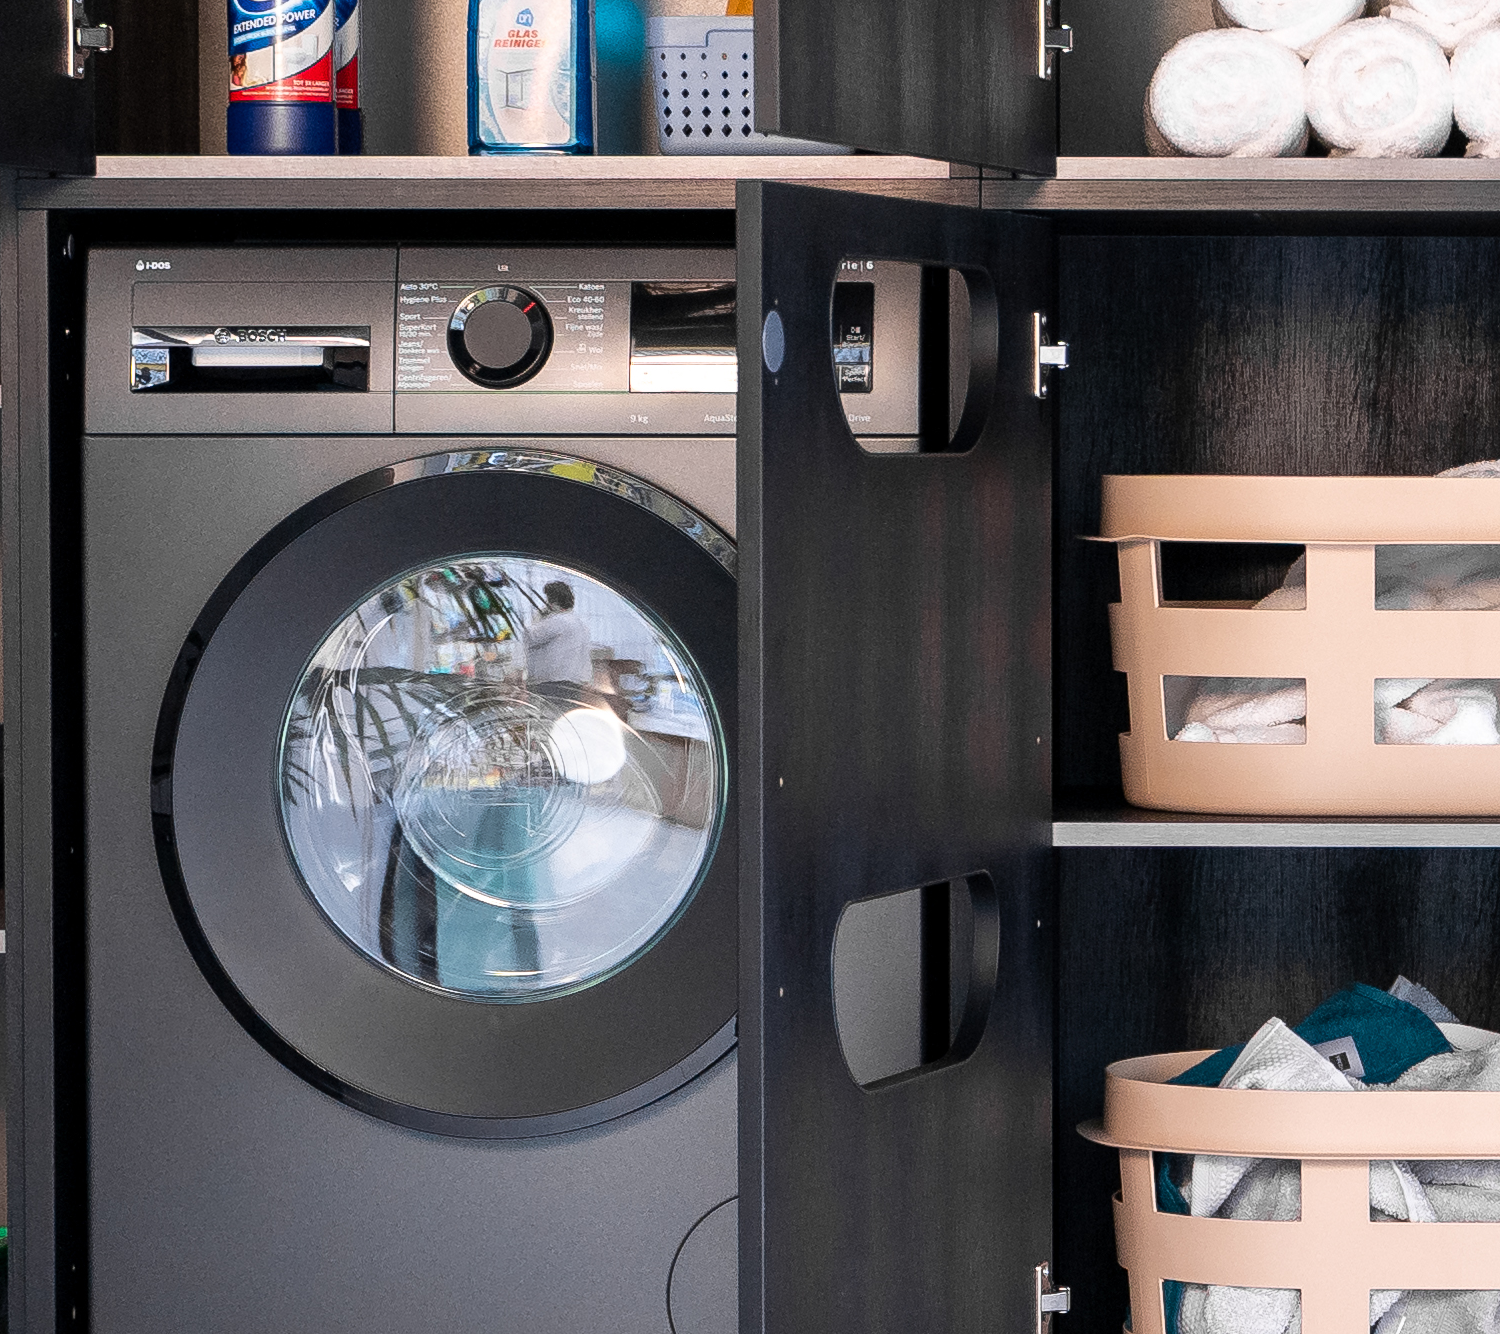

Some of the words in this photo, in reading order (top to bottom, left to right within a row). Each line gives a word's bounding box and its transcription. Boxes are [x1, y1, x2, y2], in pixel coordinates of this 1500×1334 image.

[281, 9, 316, 26] POWER
[233, 15, 277, 35] EXTENDED
[507, 29, 539, 39] GLAS
[866, 260, 874, 270] 6
[400, 296, 430, 304] Hygiene
[399, 313, 421, 322] Sport
[565, 323, 583, 332] Fijne
[236, 328, 288, 343] BOSCH
[588, 346, 604, 354] Wol
[630, 414, 637, 423] 9
[638, 414, 649, 424] kg
[848, 414, 872, 422] Drive
